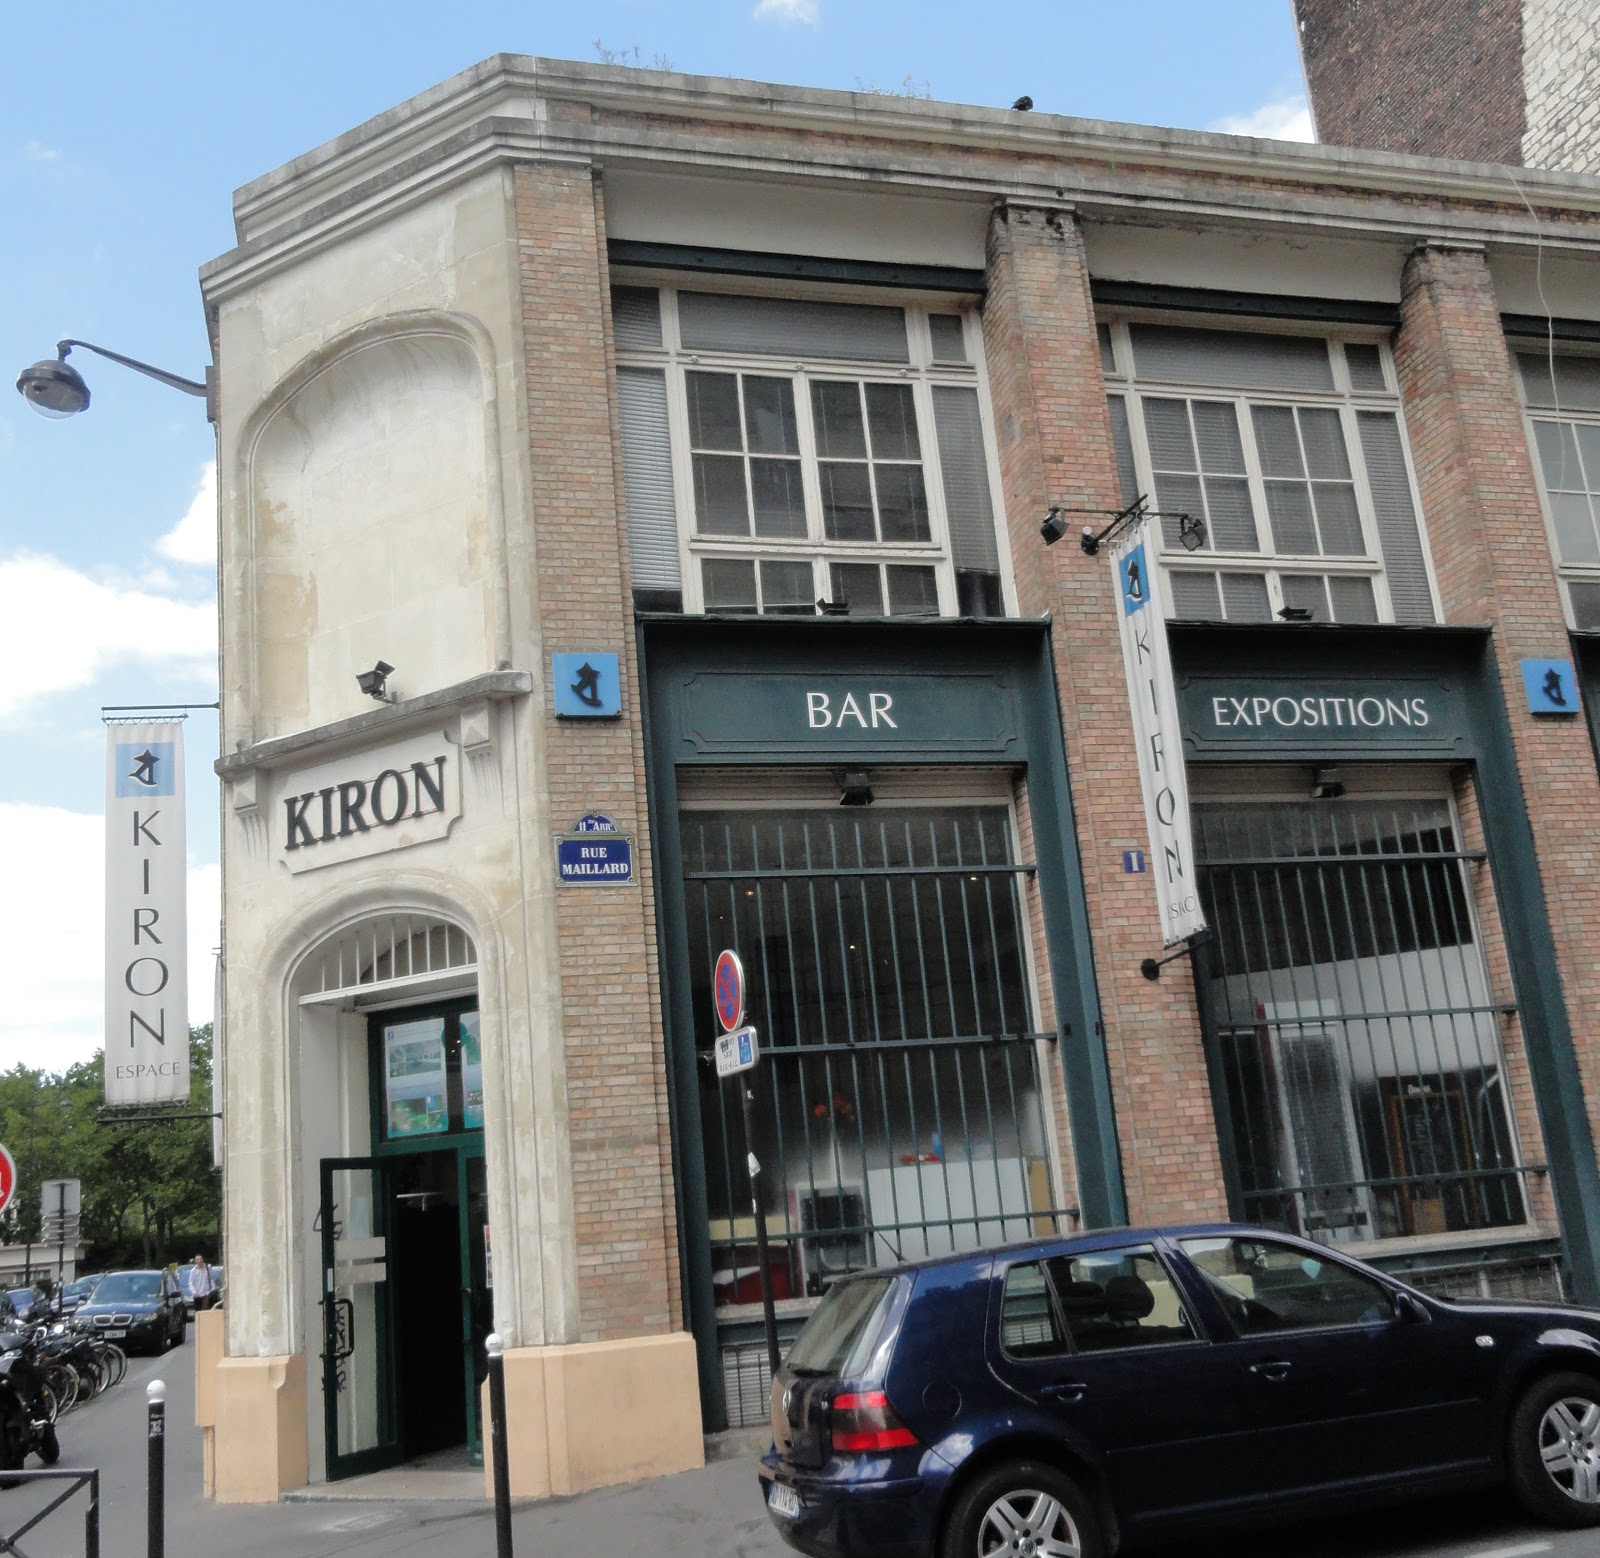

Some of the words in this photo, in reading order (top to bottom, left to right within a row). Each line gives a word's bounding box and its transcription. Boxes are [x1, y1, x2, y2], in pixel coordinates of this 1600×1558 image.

[806, 692, 898, 728] BAR
[1212, 697, 1429, 727] EXPOSITIONS
[284, 755, 447, 850] KIRON
[581, 847, 608, 858] RUE
[562, 863, 629, 875] MAILLARD
[125, 810, 169, 1049] KIRON
[116, 1061, 181, 1079] ESPACE
